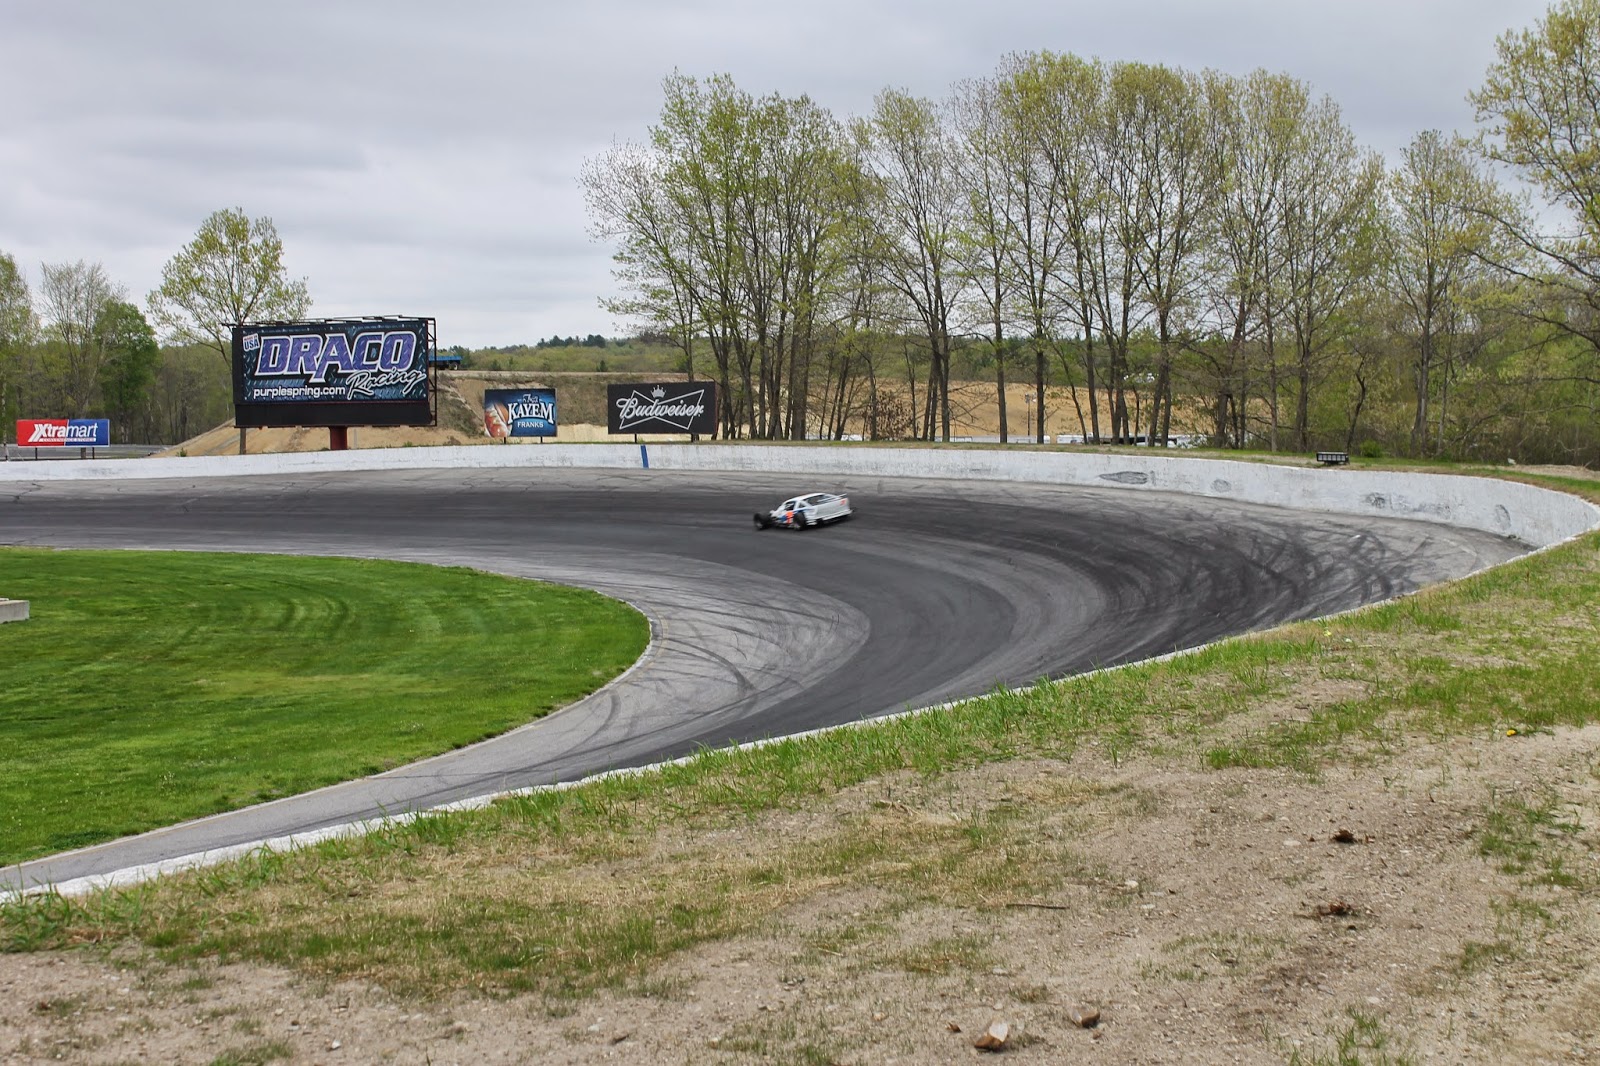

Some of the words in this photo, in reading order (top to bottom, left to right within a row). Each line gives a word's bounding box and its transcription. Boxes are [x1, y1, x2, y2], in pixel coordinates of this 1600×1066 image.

[244, 338, 259, 350] USA
[255, 331, 416, 383] DRACO
[253, 385, 346, 399] purplespring.com
[346, 367, 426, 400] Racing
[507, 402, 554, 424] KAYEM
[616, 398, 704, 419] Budweiser
